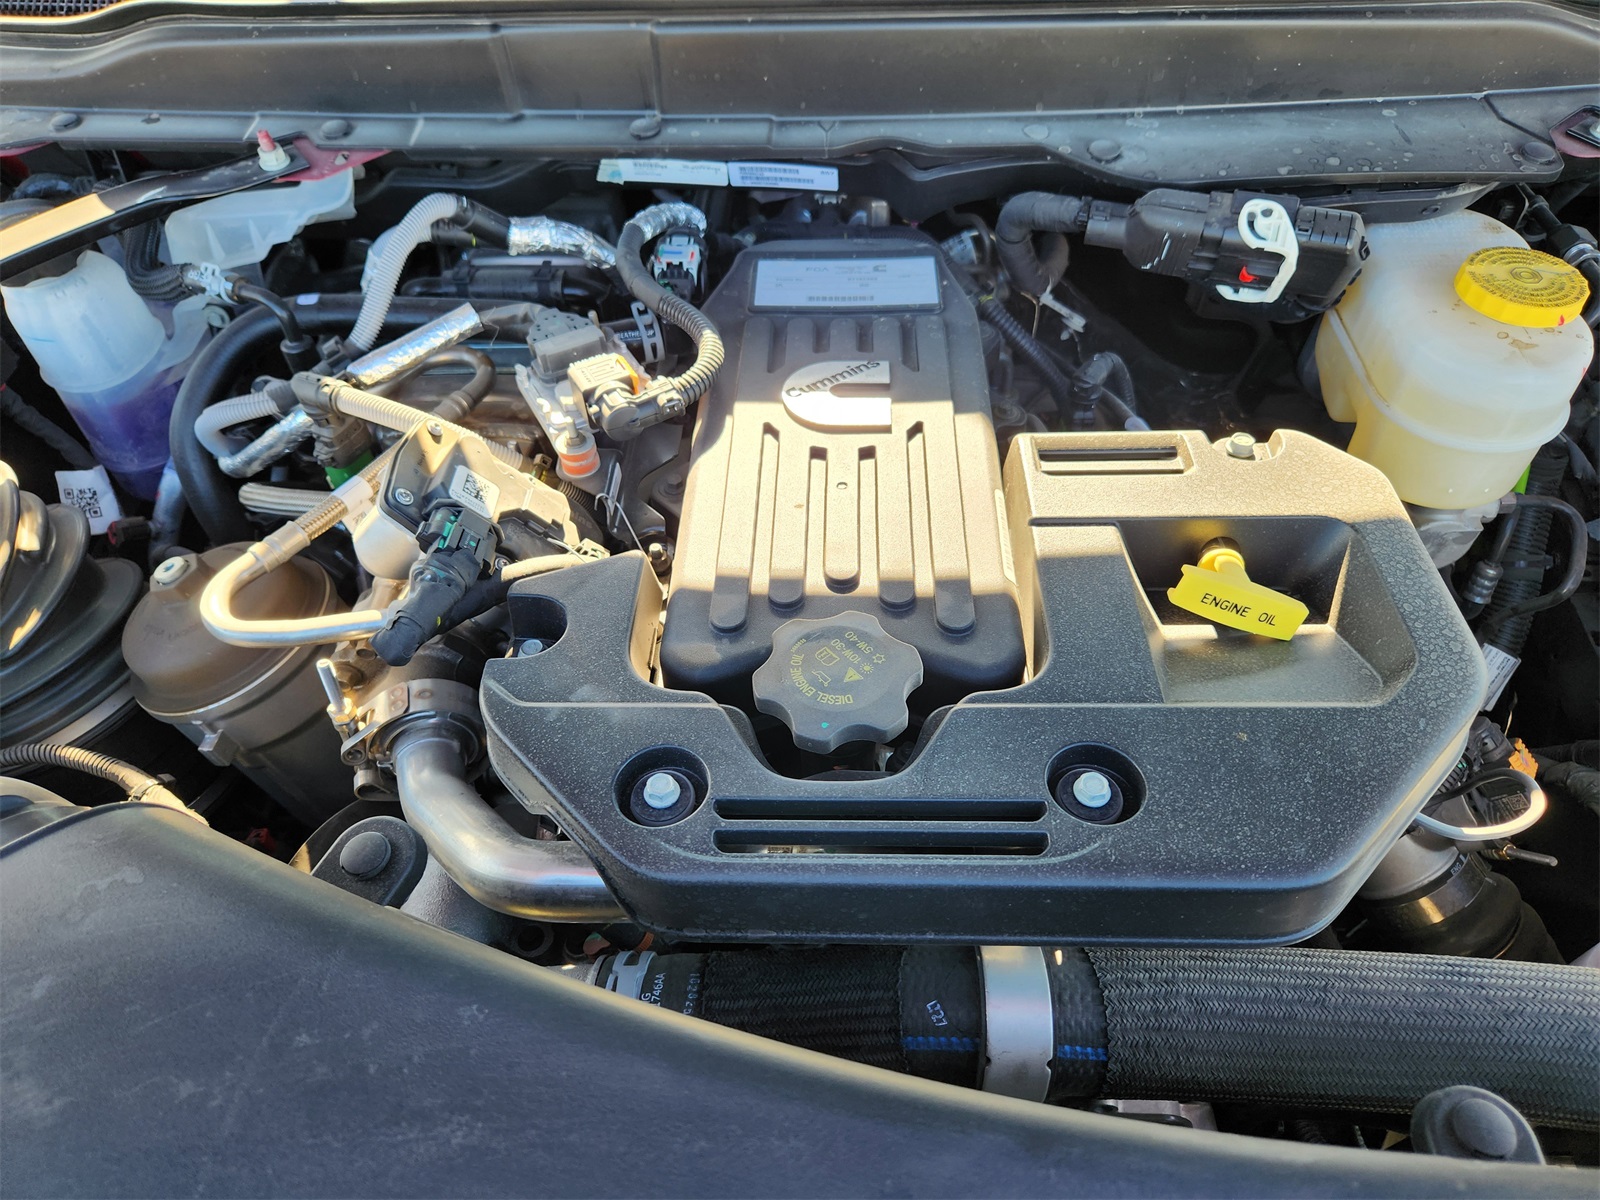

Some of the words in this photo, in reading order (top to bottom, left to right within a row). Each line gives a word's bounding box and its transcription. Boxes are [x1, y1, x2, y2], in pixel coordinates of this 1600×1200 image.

[785, 360, 880, 397] Cummins
[1200, 592, 1252, 618] ENGINE
[1257, 612, 1276, 627] OIL
[830, 638, 861, 664] 10W-30
[844, 631, 874, 654] 5W-40
[790, 653, 805, 666] OIL
[790, 667, 817, 697] ENGINE
[816, 691, 854, 705] DIESEL
